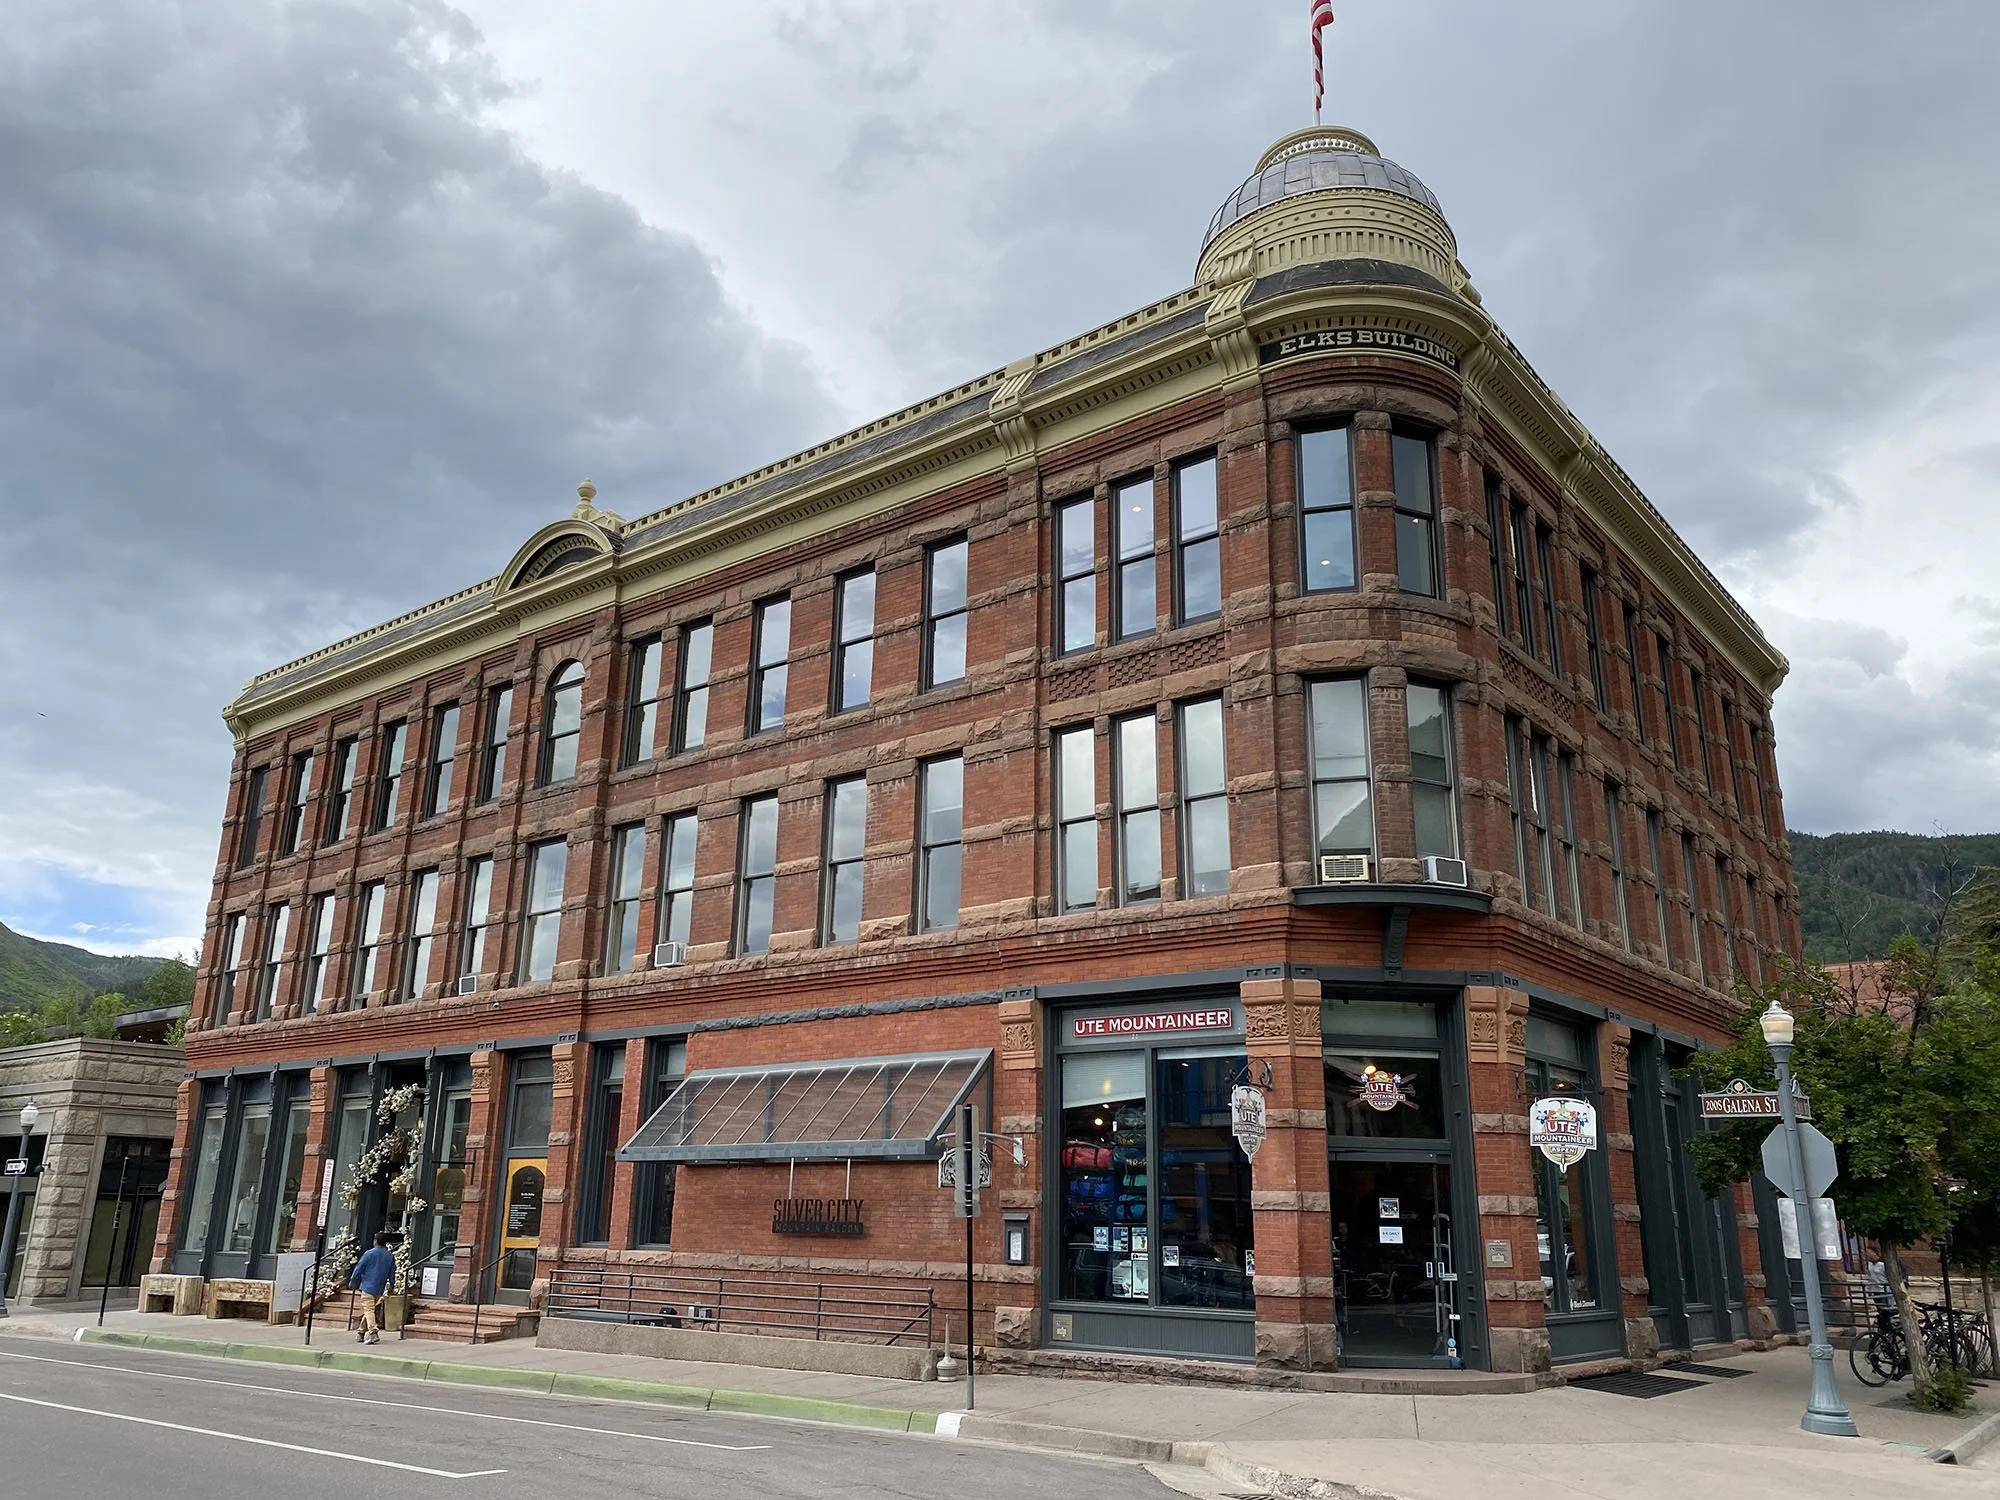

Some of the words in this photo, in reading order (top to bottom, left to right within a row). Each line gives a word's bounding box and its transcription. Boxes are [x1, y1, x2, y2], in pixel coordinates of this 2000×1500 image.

[1279, 330, 1353, 355] ELKS
[1356, 330, 1456, 366] BUILDING
[1075, 1020, 1105, 1034] UTE
[1109, 1011, 1229, 1032] MOUNTAINEER
[1370, 1083, 1393, 1092] UTE
[1722, 1097, 1762, 1114] GALENA
[1241, 1110, 1257, 1123] UTE
[1547, 1121, 1578, 1134] UTE
[1534, 1135, 1593, 1145] MOUNTAINEER
[773, 1199, 823, 1222] SILVER
[827, 1199, 864, 1223] CITY
[774, 1223, 820, 1233] MOUNTAIN
[824, 1223, 860, 1233] SALOON
